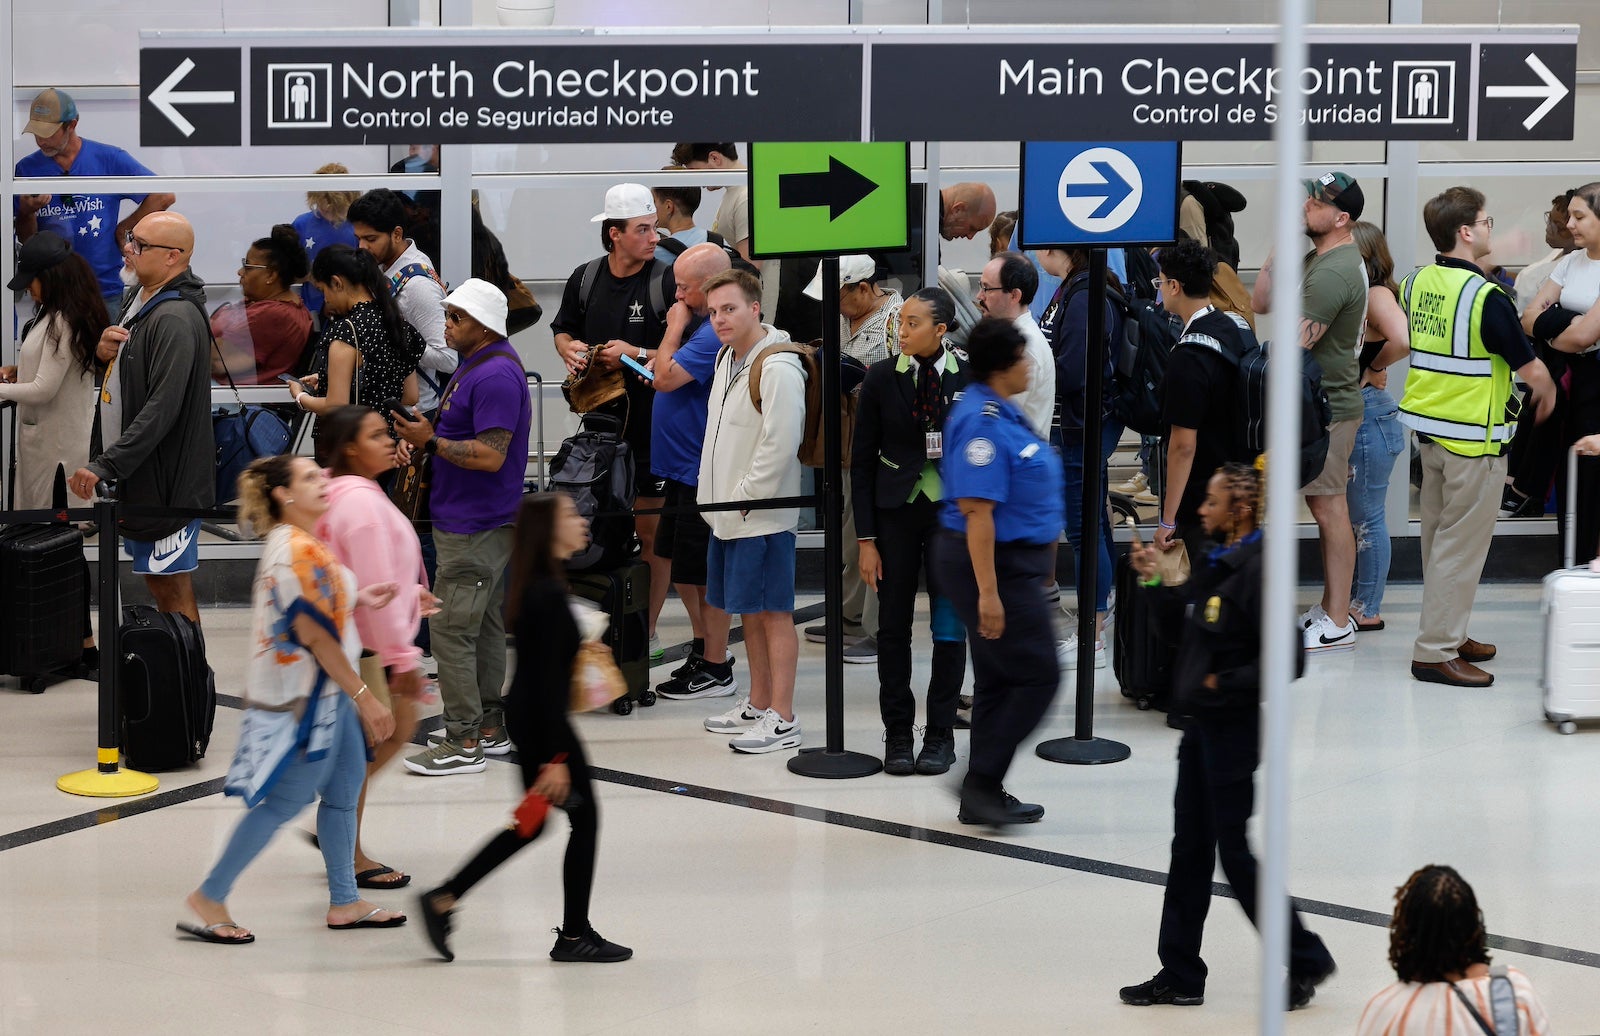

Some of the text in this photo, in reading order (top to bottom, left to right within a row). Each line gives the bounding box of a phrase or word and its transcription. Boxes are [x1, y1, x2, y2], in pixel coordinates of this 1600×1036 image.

[342, 59, 760, 104] North Checkpoint
[999, 57, 1383, 103] Main Checkpoint
[342, 105, 674, 130] Control de Seguridad Norte
[1132, 103, 1382, 126] Control de Sguridad
[1418, 291, 1446, 315] AIRPORT
[1411, 311, 1447, 338] OPERATIONS
[154, 525, 189, 558] NIKE
